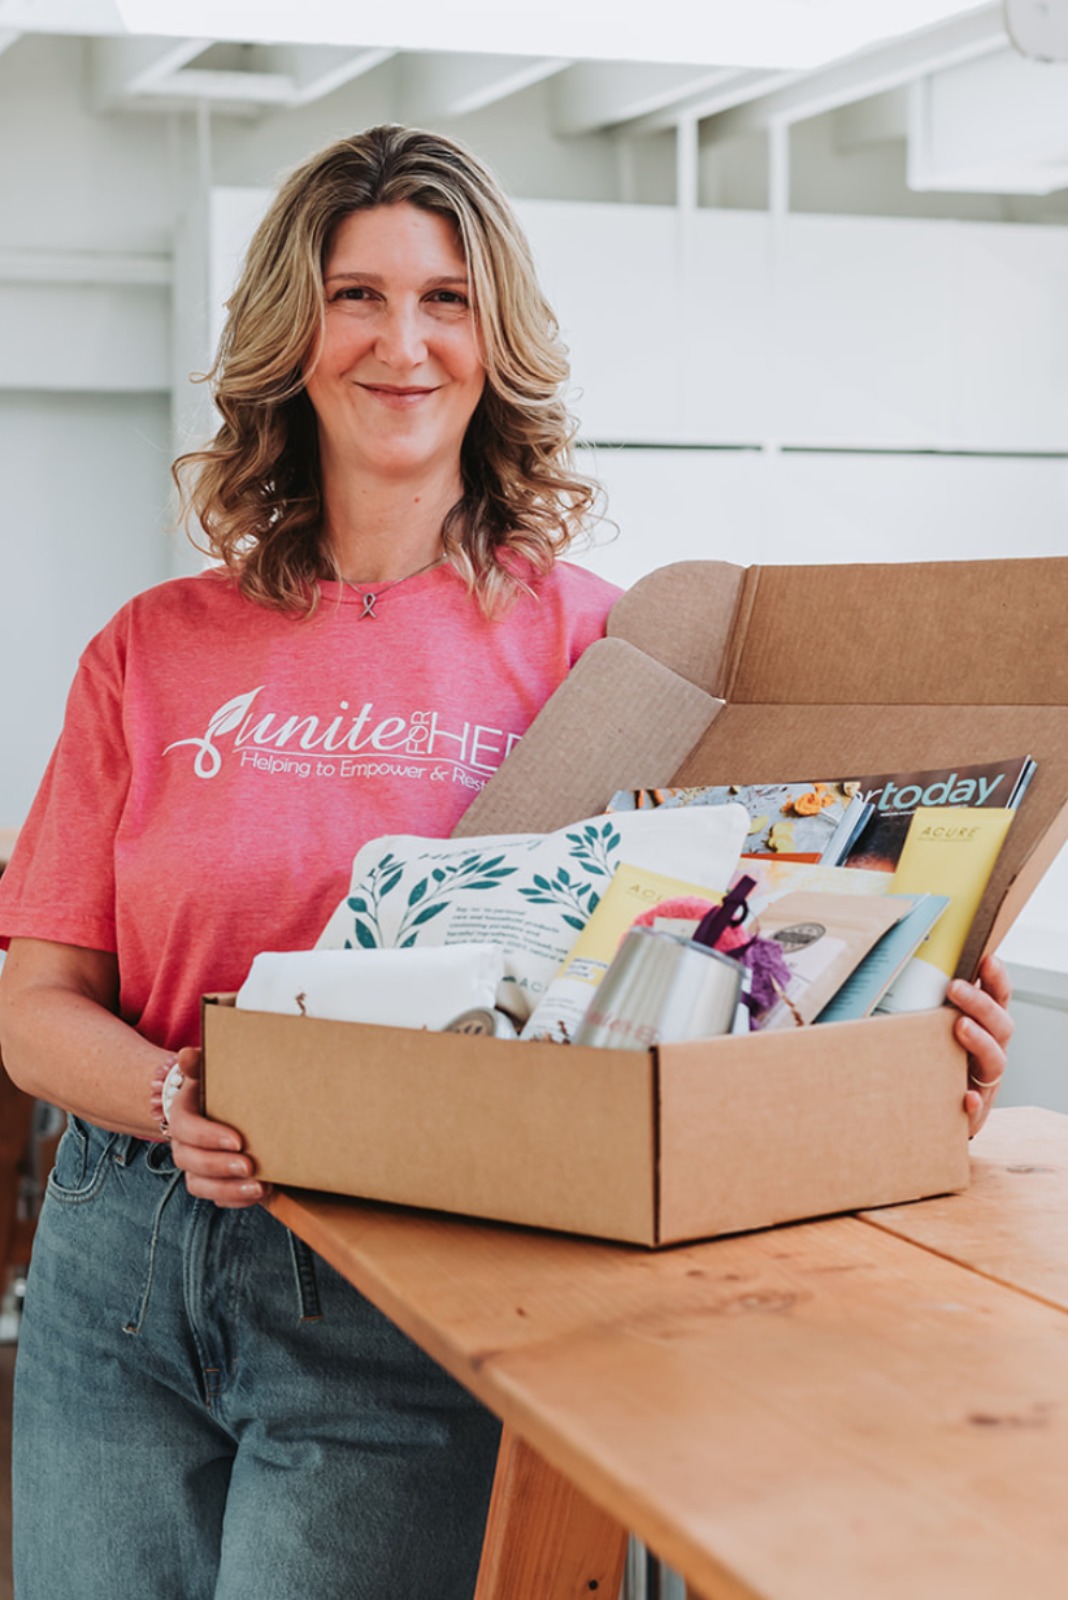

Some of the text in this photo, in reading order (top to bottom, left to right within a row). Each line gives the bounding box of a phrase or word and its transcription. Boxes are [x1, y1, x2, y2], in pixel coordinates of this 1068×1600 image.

[234, 700, 417, 752] unite
[405, 711, 431, 754] FOR
[240, 751, 311, 777] Helping
[316, 762, 336, 776] to
[340, 760, 427, 779] Empower
[430, 766, 449, 781] &
[920, 825, 981, 838] ACURE
